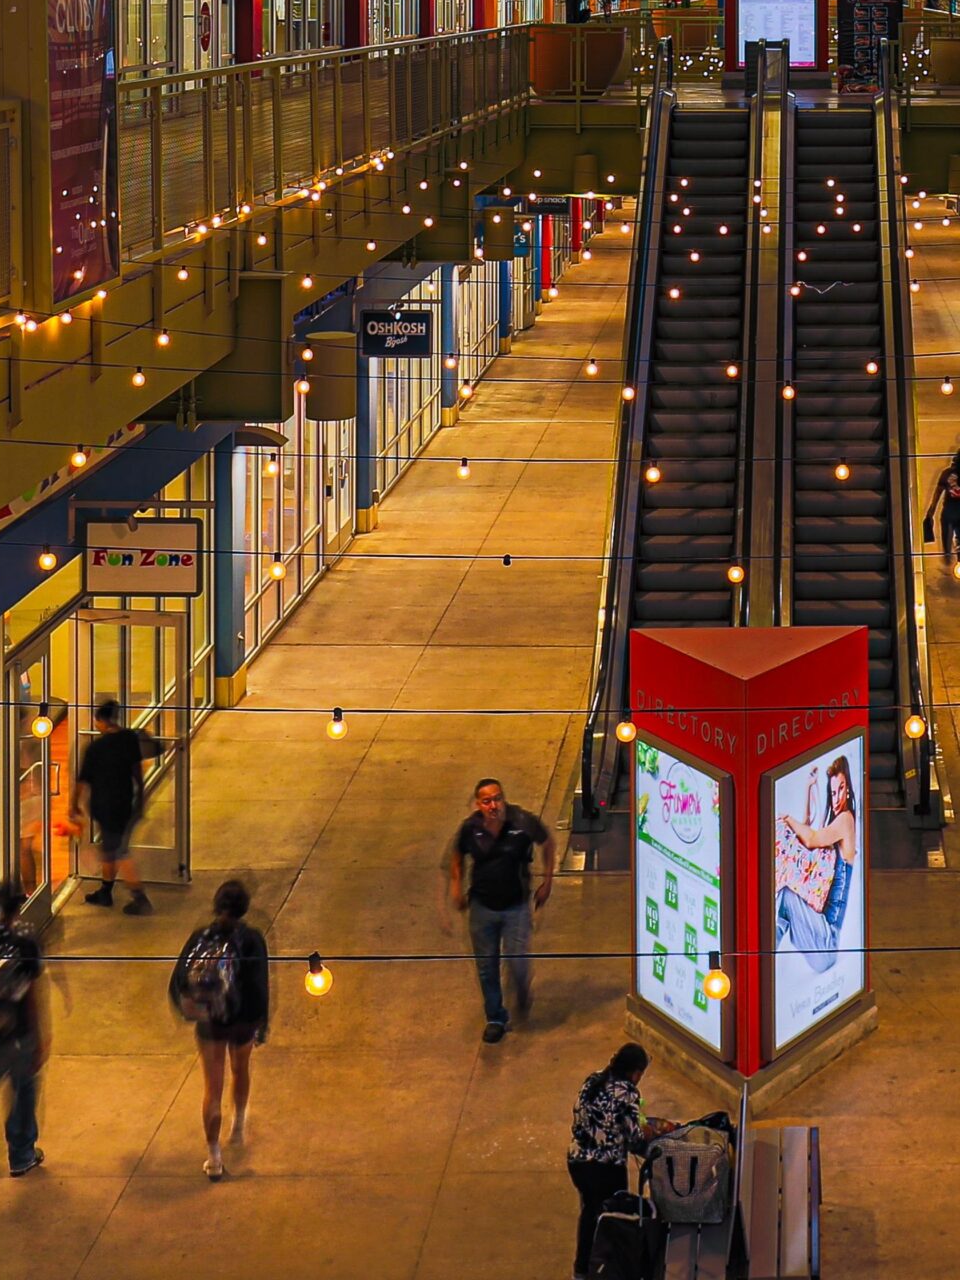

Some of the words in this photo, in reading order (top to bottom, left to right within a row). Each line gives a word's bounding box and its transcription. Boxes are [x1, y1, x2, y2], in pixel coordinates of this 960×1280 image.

[92, 549, 134, 567] Fun
[139, 549, 194, 567] Zone
[636, 689, 737, 755] DIRECTORY
[756, 688, 860, 756] DIRECTORY
